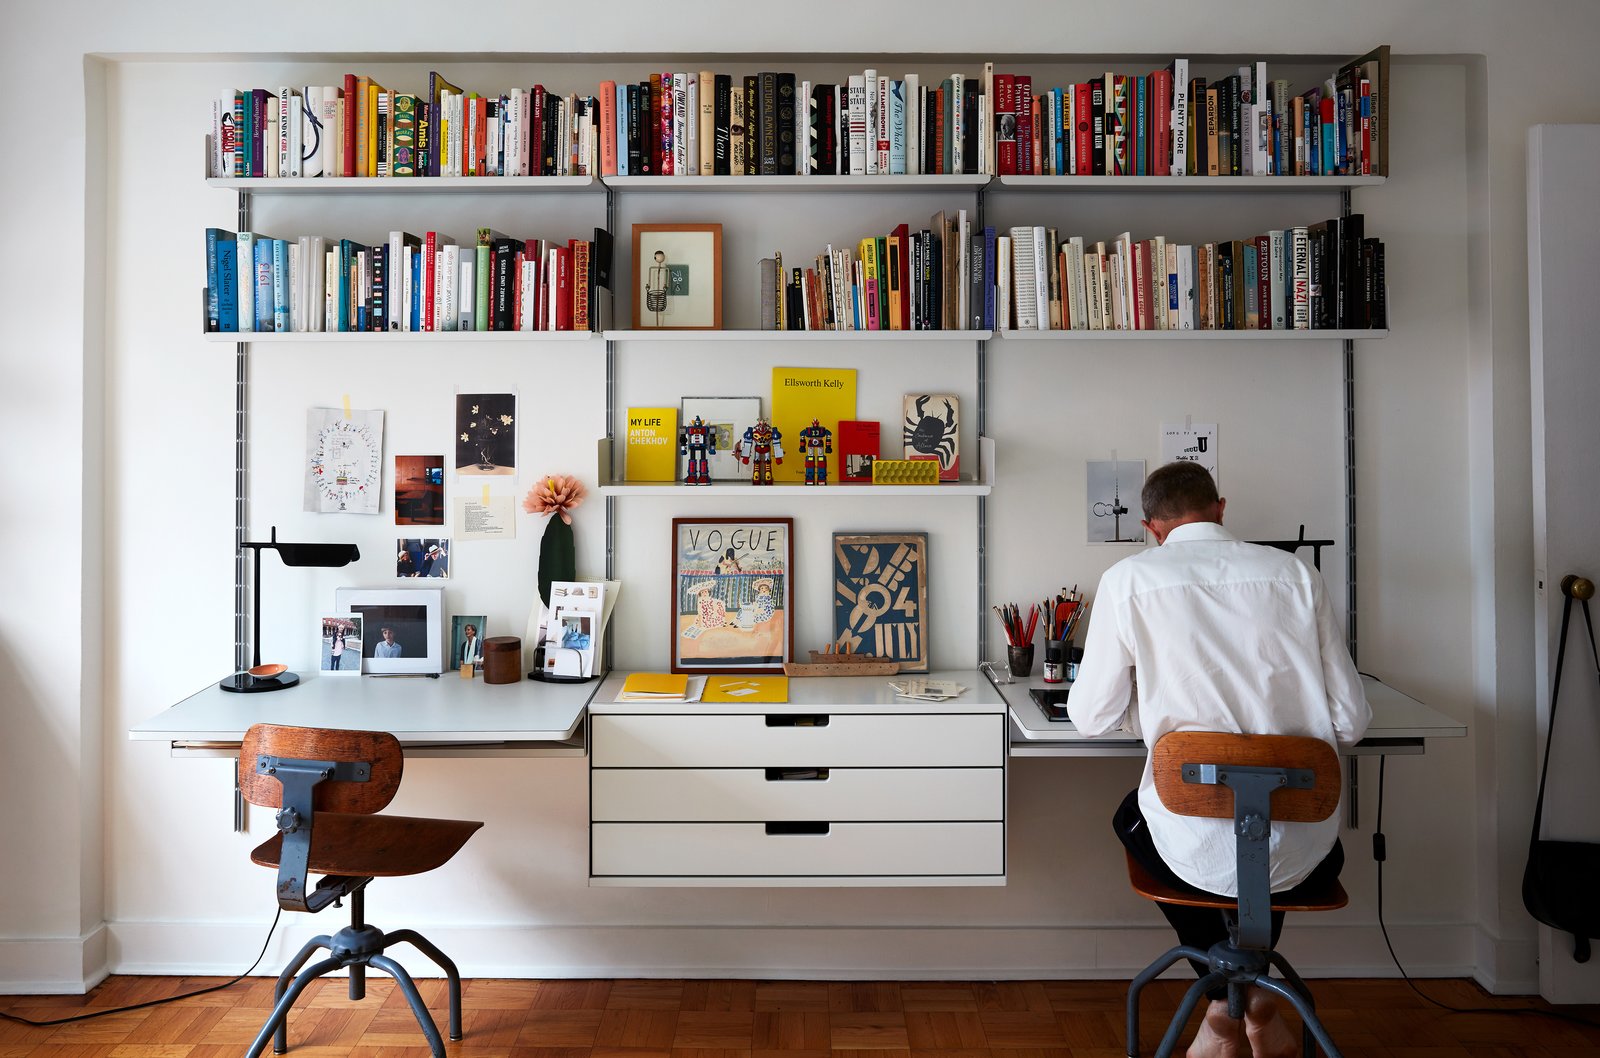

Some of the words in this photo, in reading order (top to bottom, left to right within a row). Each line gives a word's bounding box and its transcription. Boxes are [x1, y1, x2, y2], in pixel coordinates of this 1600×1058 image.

[675, 90, 686, 118] LOWLAND
[765, 75, 775, 114] CULTURAL
[1015, 83, 1023, 117] Pamuk
[1023, 84, 1032, 116] Orhan
[894, 101, 903, 119] The
[1177, 93, 1185, 127] PLENTY
[281, 131, 288, 139] OF
[418, 120, 429, 149] Amis
[765, 116, 775, 156] AMNESIA
[894, 120, 903, 151] Whale
[1017, 125, 1024, 133] of
[1094, 116, 1103, 134] NAOMI
[717, 127, 729, 160] Them
[1094, 134, 1103, 150] KLEIN
[1177, 129, 1185, 155] MORE
[678, 145, 686, 167] Lahiri
[222, 250, 232, 271] Nigel
[446, 251, 454, 266] Engel
[499, 259, 507, 275] WEISS
[579, 245, 587, 286] MICHAEL
[1260, 240, 1269, 281] ZEITOUN
[1296, 237, 1307, 276] ETERNAL
[224, 273, 232, 296] Slater
[260, 263, 270, 287] 1913
[499, 276, 507, 287] UND
[499, 288, 507, 312] SCHWARZ
[1296, 281, 1307, 303] NAZI
[579, 287, 587, 325] CHABON
[784, 378, 822, 387] Ellsworth
[824, 379, 844, 390] Kelly
[630, 418, 642, 426] MY
[644, 418, 662, 426] LIFE
[630, 429, 656, 437] ANTON
[630, 437, 668, 445] CHEKHOV
[689, 529, 778, 552] VOGUE
